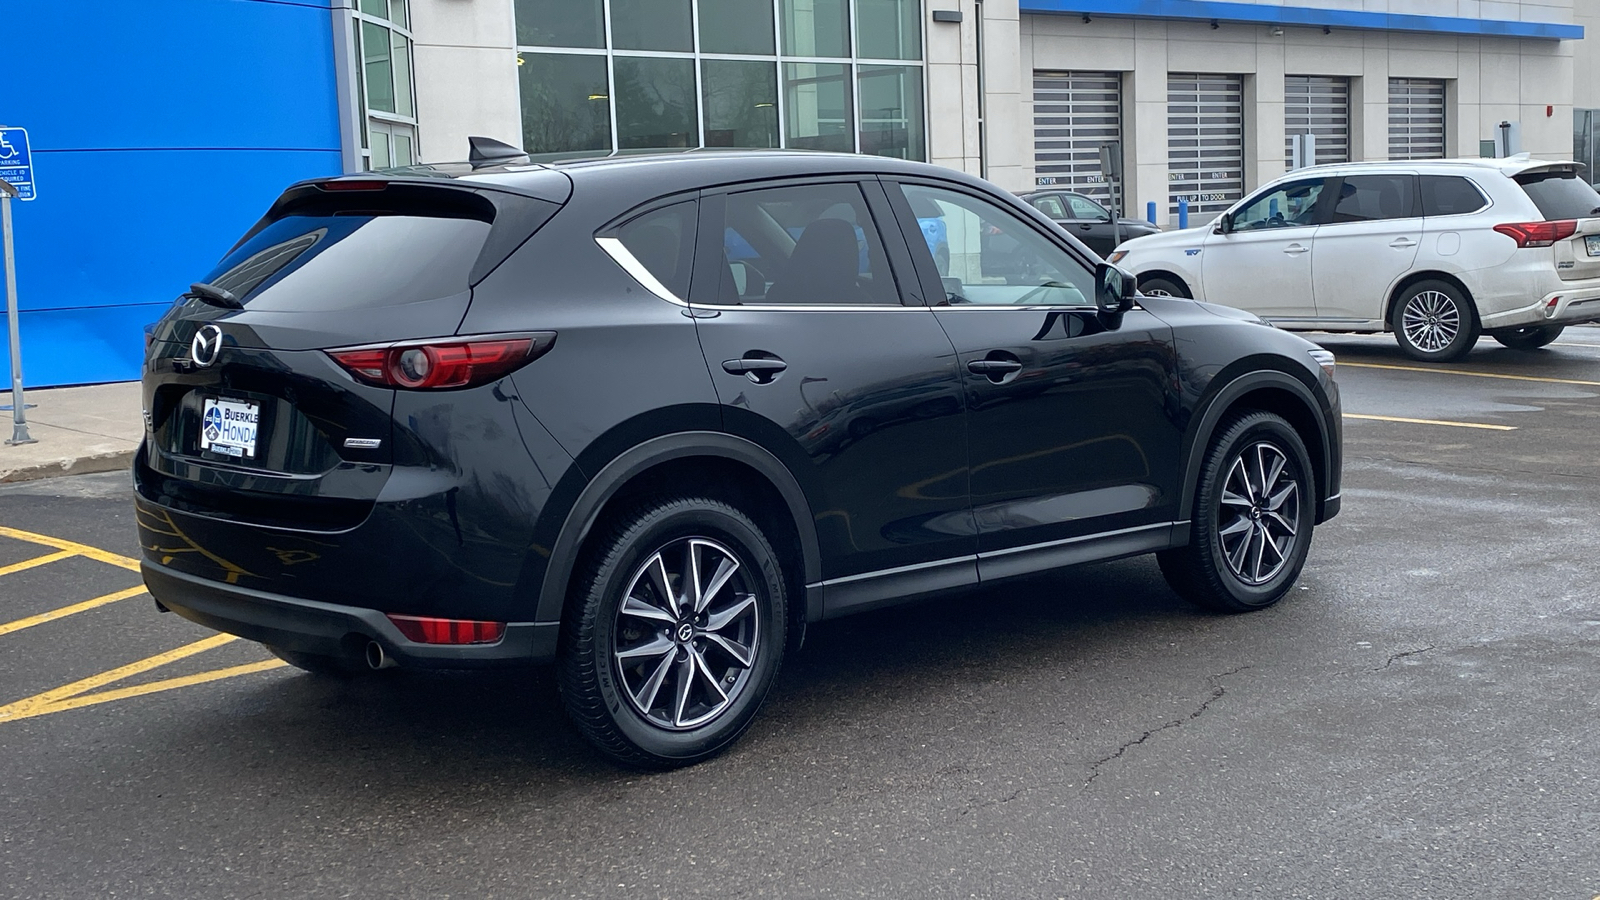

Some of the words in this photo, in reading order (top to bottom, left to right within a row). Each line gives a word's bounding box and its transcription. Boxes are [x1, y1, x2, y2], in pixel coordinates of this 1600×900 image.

[1038, 177, 1057, 185] ENTER
[224, 408, 258, 423] BUERKLE
[222, 421, 256, 443] HONDA
